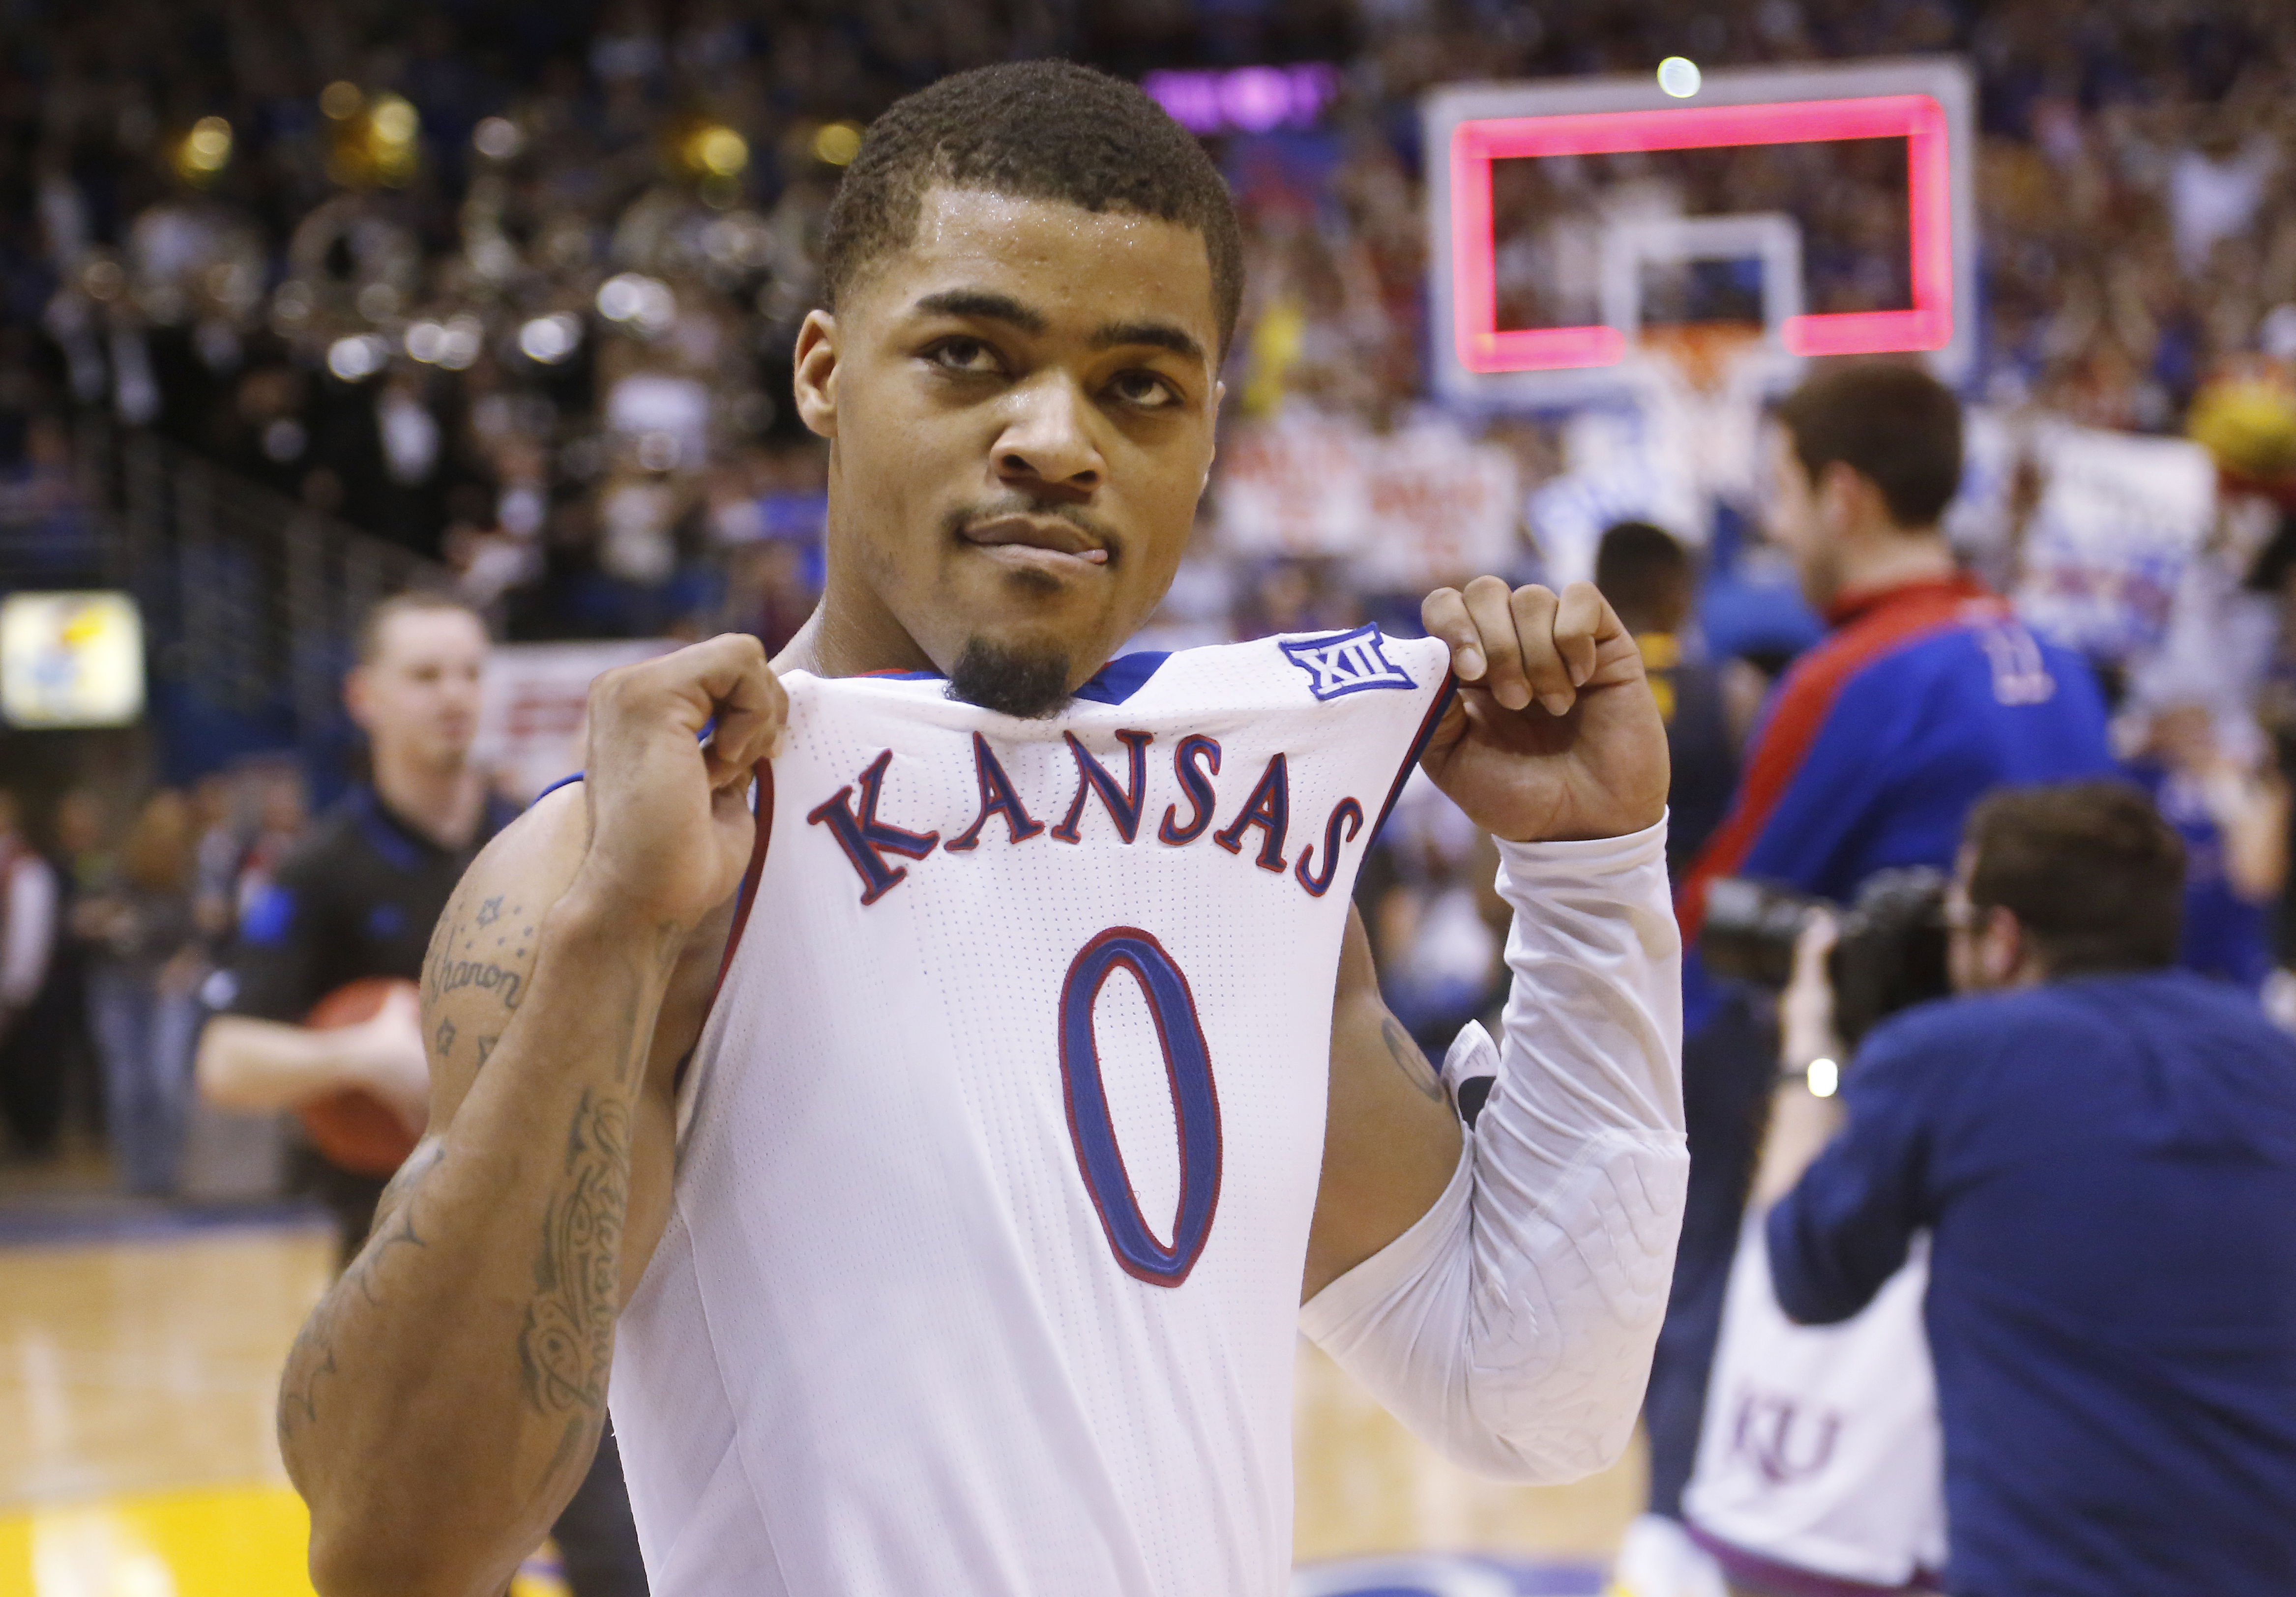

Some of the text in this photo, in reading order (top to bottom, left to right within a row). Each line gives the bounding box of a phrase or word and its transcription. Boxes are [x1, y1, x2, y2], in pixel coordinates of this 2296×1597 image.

[1285, 627, 1411, 697] XII
[807, 728, 1363, 905] KANSAS
[1058, 926, 1223, 1288] 0
